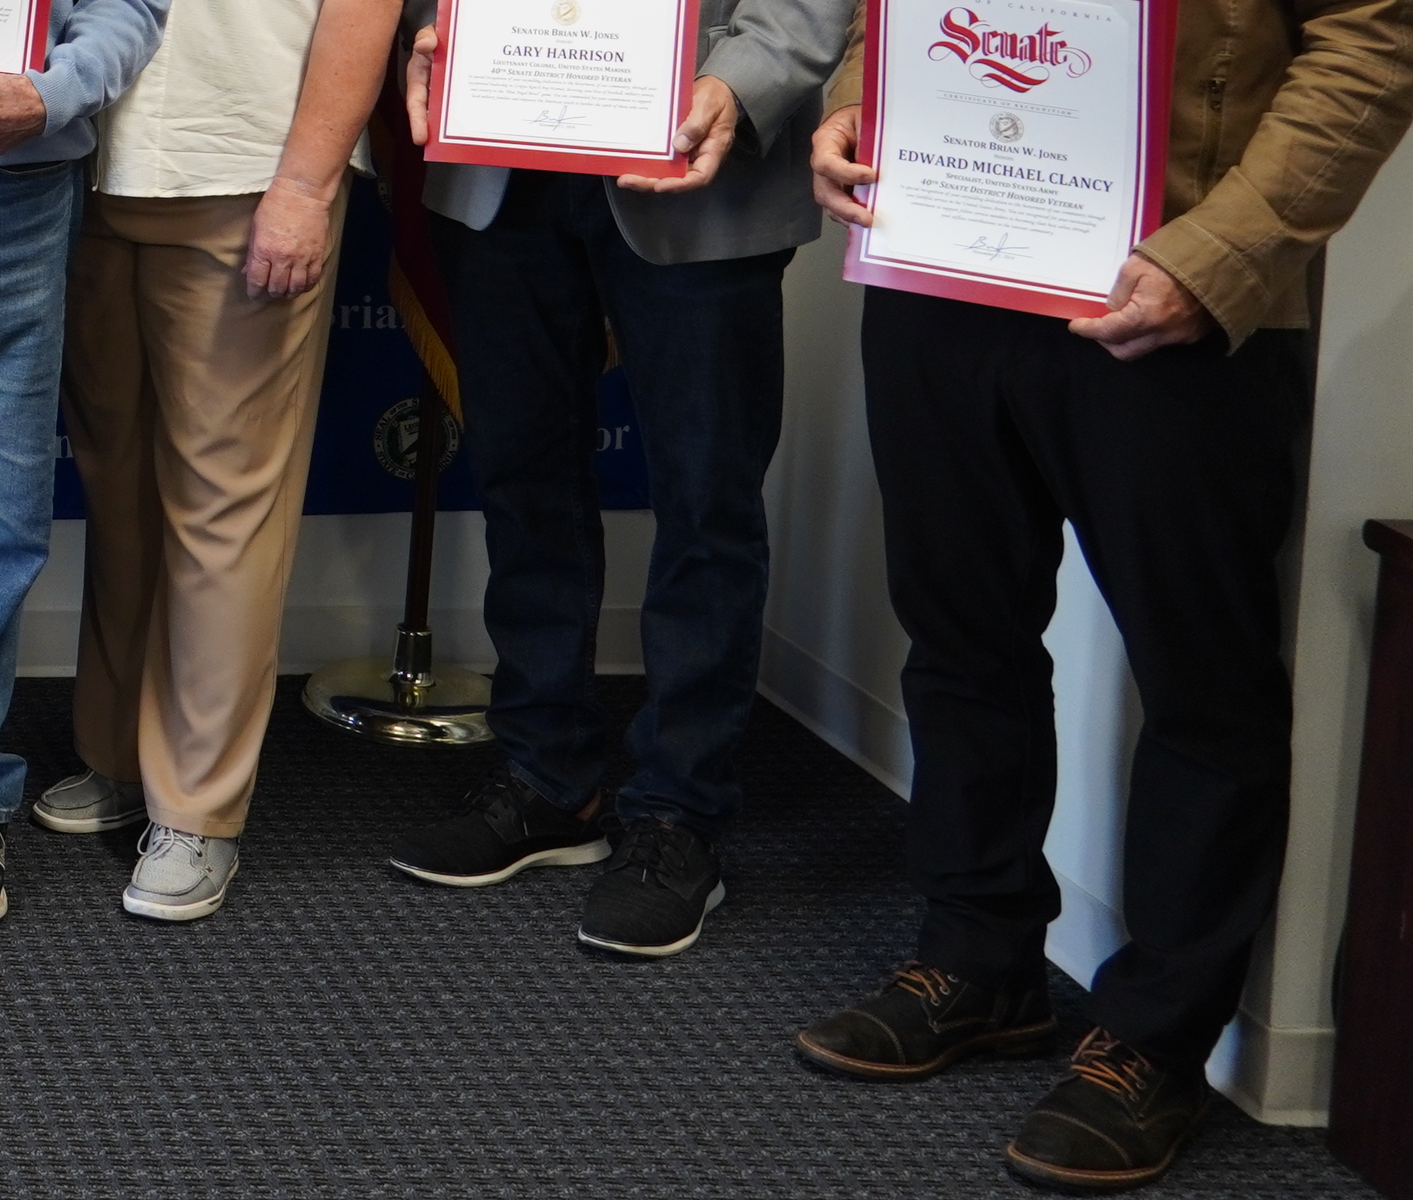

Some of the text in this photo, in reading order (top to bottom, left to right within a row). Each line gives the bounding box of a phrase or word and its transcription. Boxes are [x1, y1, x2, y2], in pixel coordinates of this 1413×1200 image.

[511, 25, 620, 40] SENATOR BRIAN W. JONES
[928, 7, 1091, 80] Senate
[502, 44, 625, 63] GARY HARRISON
[943, 134, 1068, 162] SENATOR BRIAN W. JONES
[898, 148, 1114, 193] EDWARD MICHAEL CLANCY
